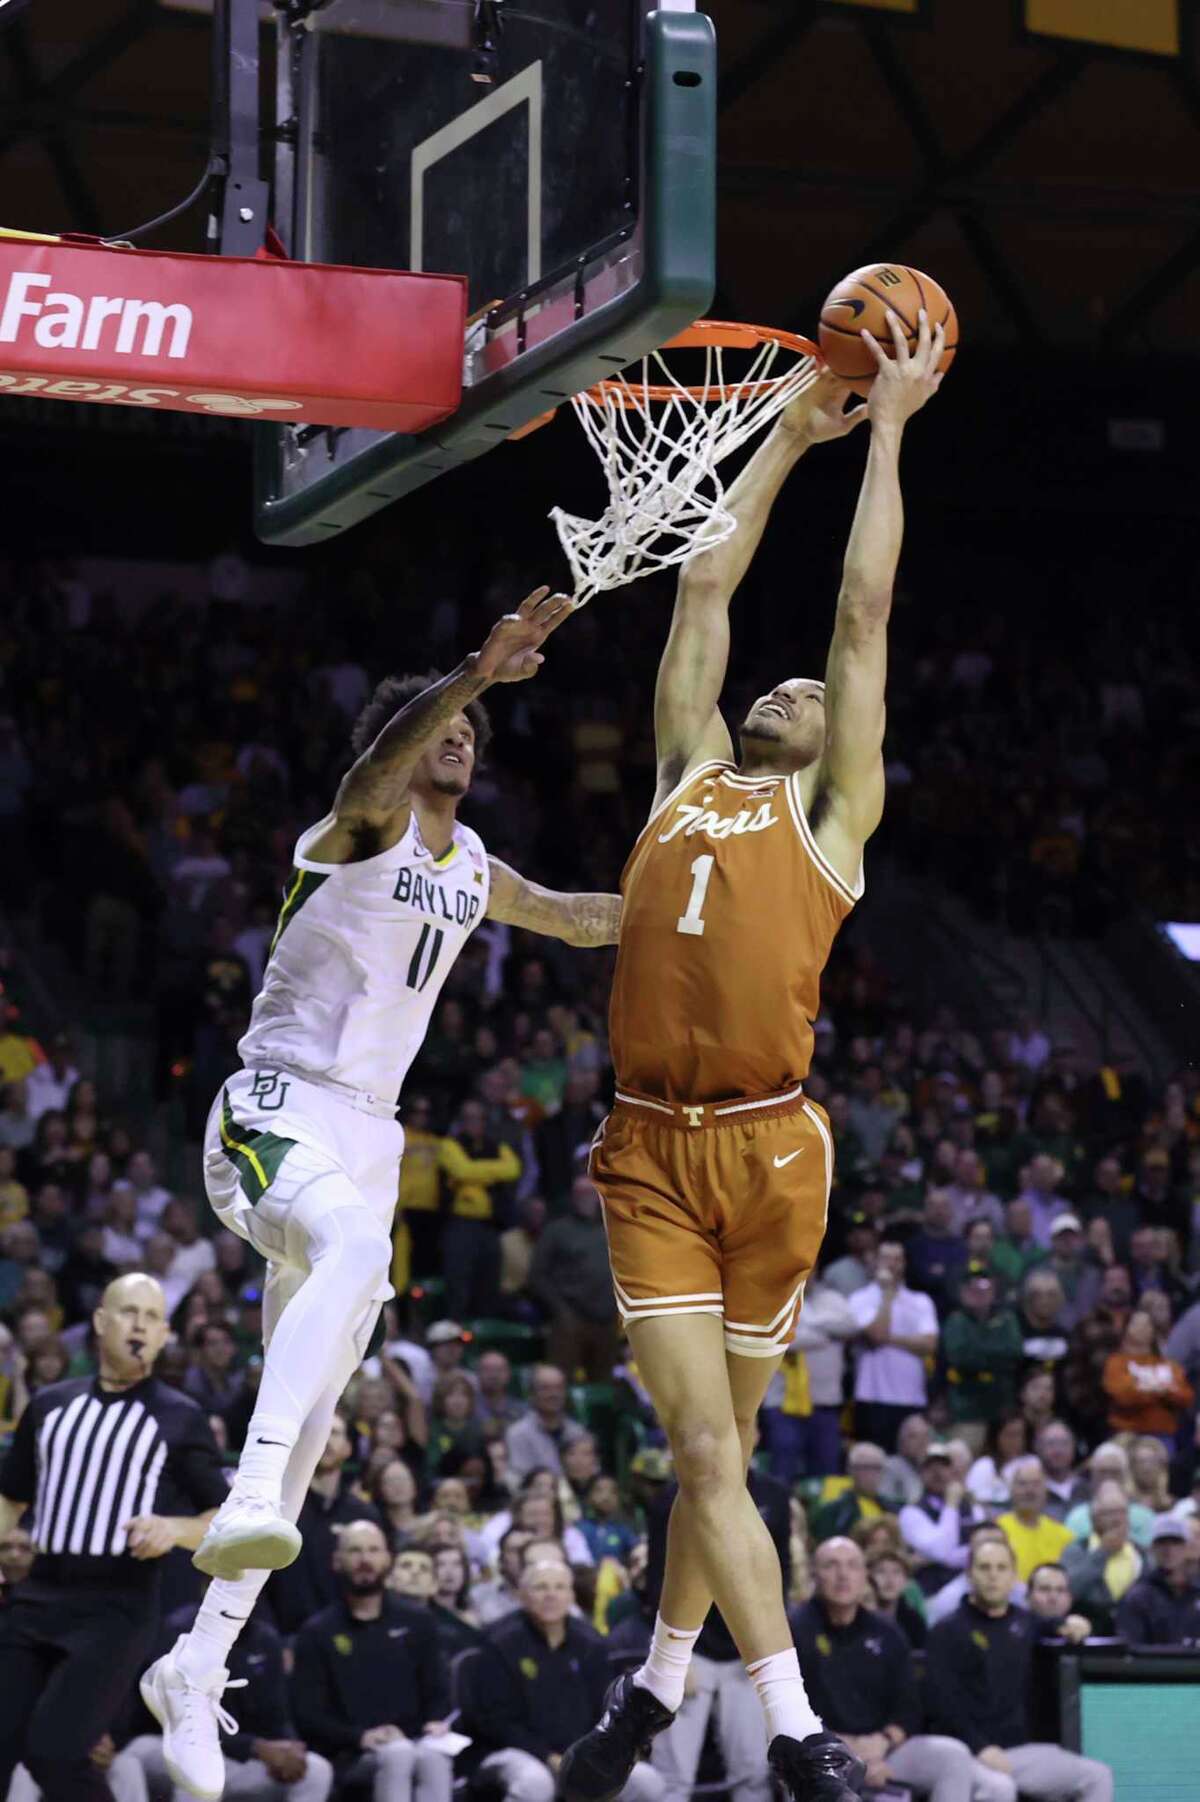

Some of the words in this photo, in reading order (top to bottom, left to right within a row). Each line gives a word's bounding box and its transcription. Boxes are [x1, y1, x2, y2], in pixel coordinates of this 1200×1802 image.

[0, 272, 192, 359] Farm
[392, 867, 479, 930] BAYLOR
[677, 854, 714, 935] 1
[406, 922, 444, 993] 11
[682, 1106, 704, 1126] T
